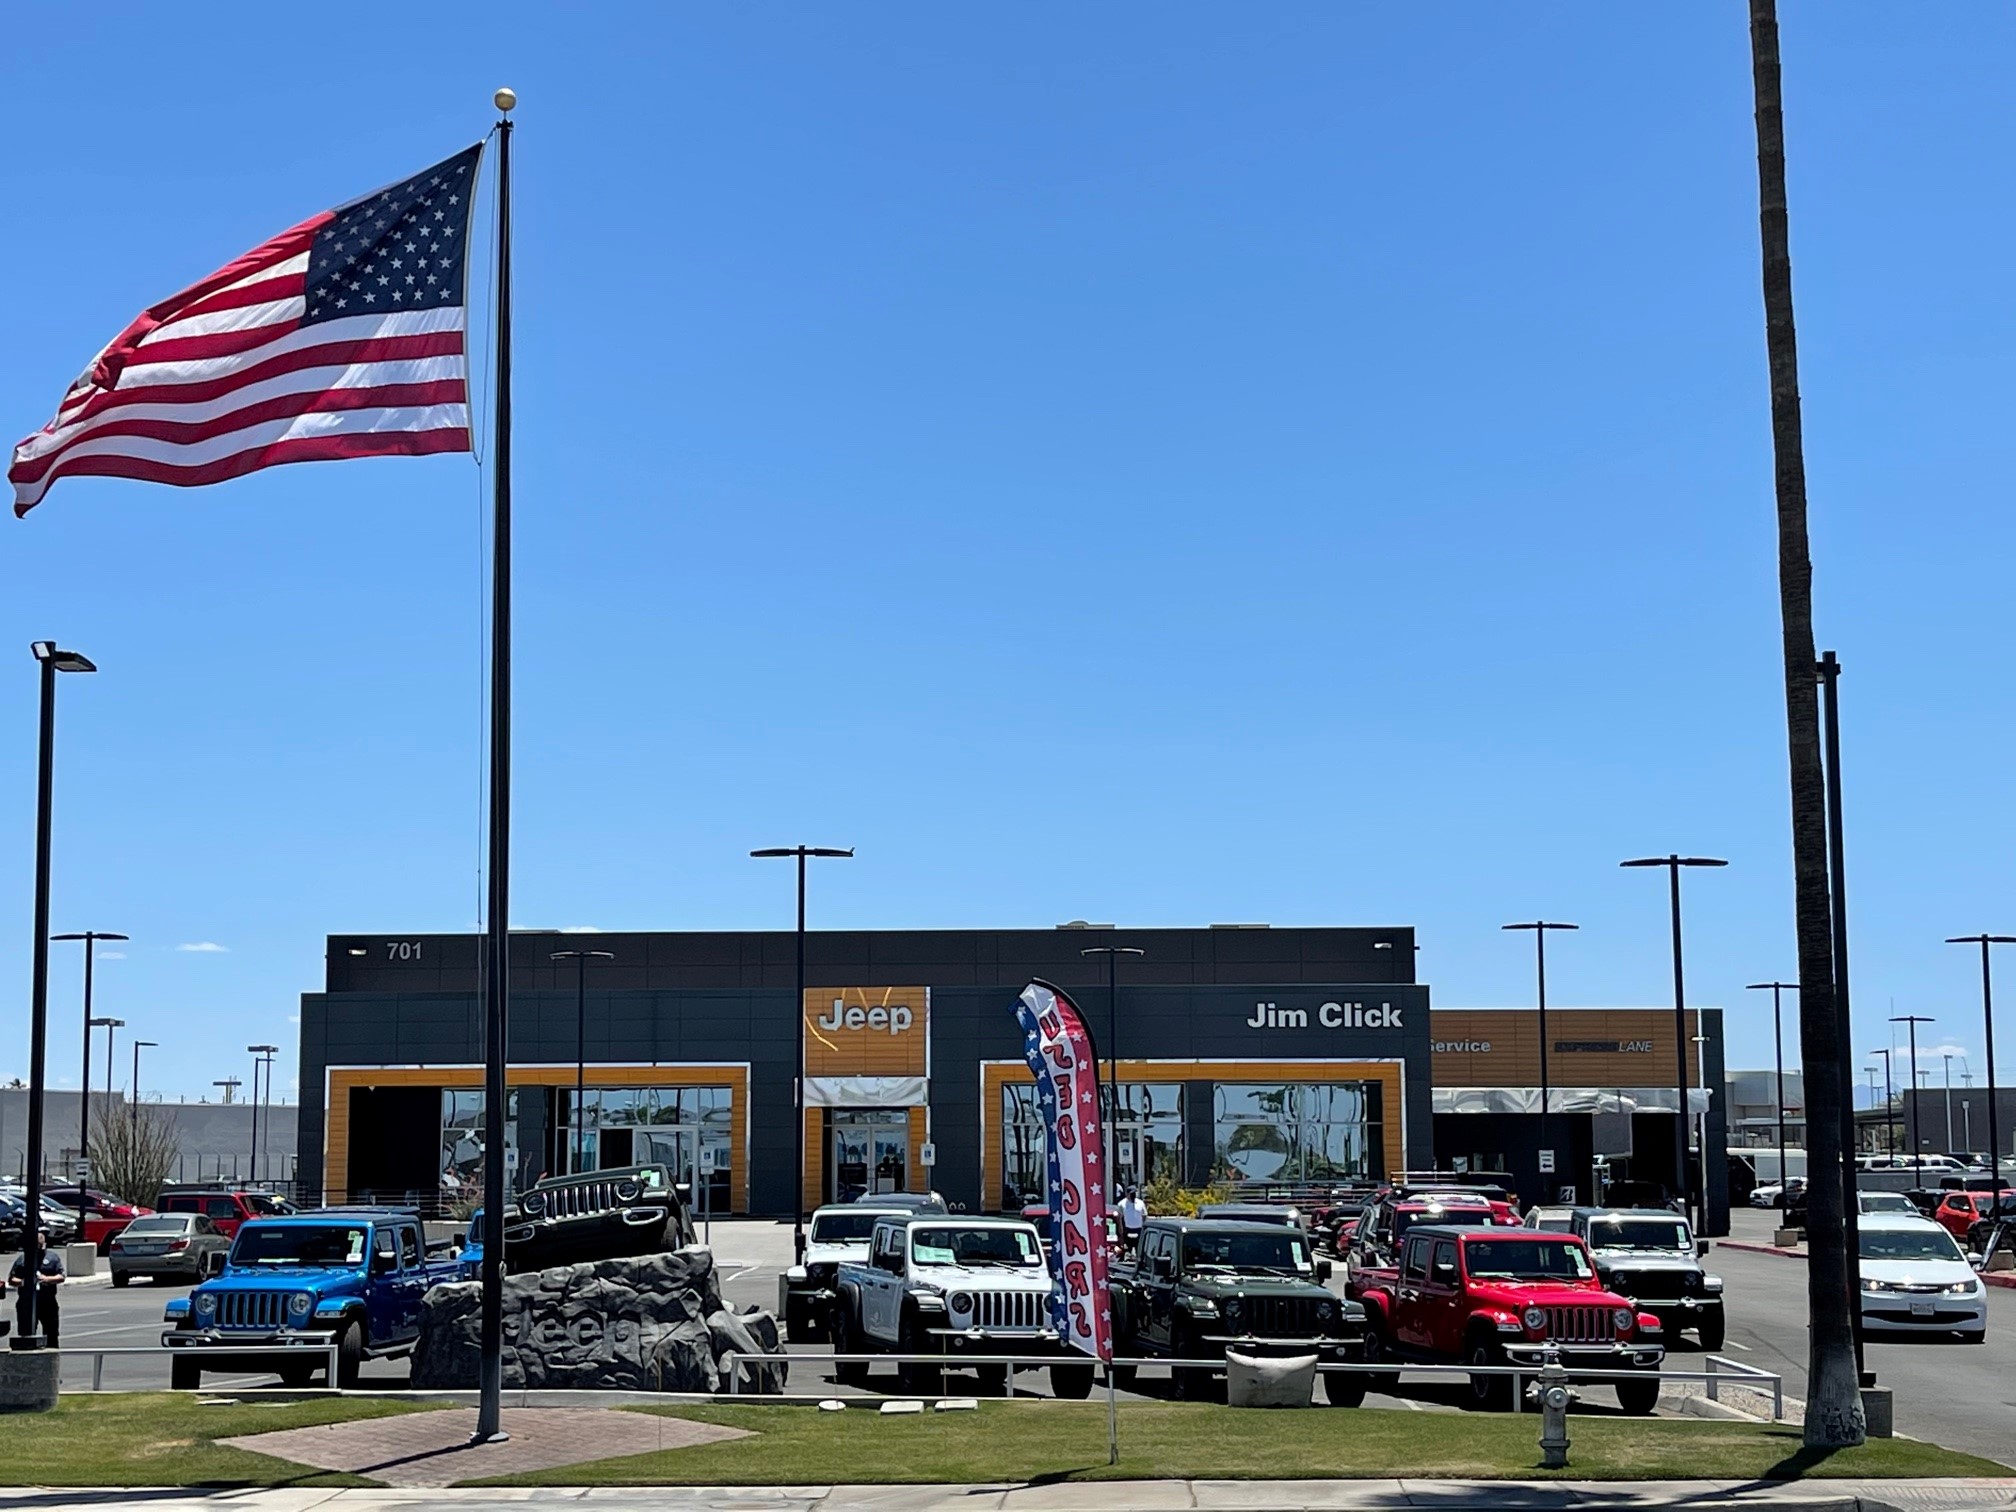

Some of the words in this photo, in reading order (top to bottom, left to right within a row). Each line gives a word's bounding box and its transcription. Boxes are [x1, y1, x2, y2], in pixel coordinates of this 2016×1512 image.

[387, 942, 421, 960] 701
[819, 999, 912, 1035] Jeep
[1247, 1003, 1308, 1028] Jim
[1319, 1002, 1403, 1028] Click
[1618, 1041, 1653, 1053] LANE
